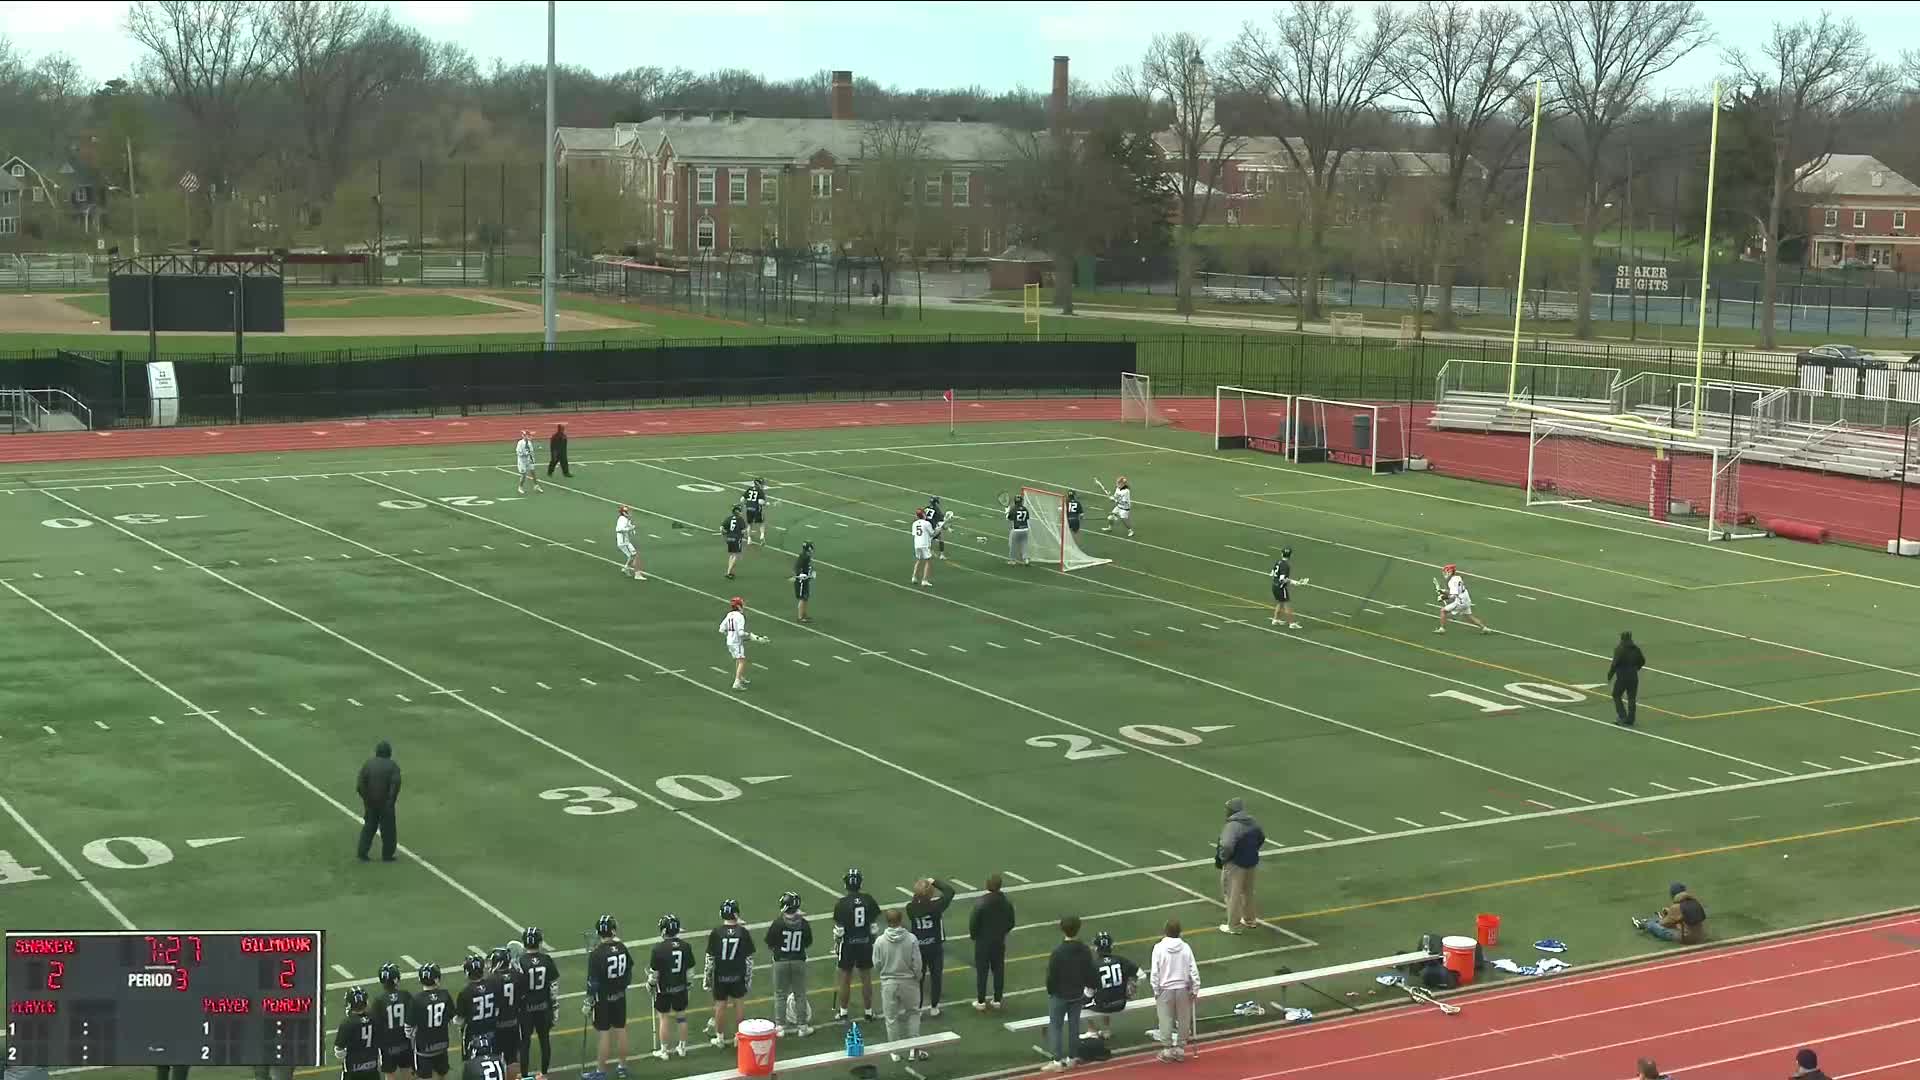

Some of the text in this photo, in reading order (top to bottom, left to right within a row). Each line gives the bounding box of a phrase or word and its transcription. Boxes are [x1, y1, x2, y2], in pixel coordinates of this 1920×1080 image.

[1616, 278, 1668, 291] HEIGHTS
[1016, 511, 1026, 521] 27
[916, 525, 923, 537] 5
[727, 618, 735, 632] 11
[1430, 681, 1588, 712] 10
[1025, 724, 1203, 760] 20
[539, 774, 743, 815] 30
[854, 907, 865, 928] 8
[916, 916, 933, 930] 16
[721, 938, 739, 960] 17
[781, 931, 802, 952] 30
[607, 954, 626, 979] 28
[671, 950, 682, 973] 3
[528, 967, 546, 990] 13
[1100, 964, 1122, 989] 20
[503, 983, 514, 1006] 9
[386, 1005, 405, 1029] 19
[427, 1003, 444, 1028] 18
[472, 993, 494, 1020] 35
[361, 1025, 373, 1047] 4
[481, 1061, 503, 1080] 21
